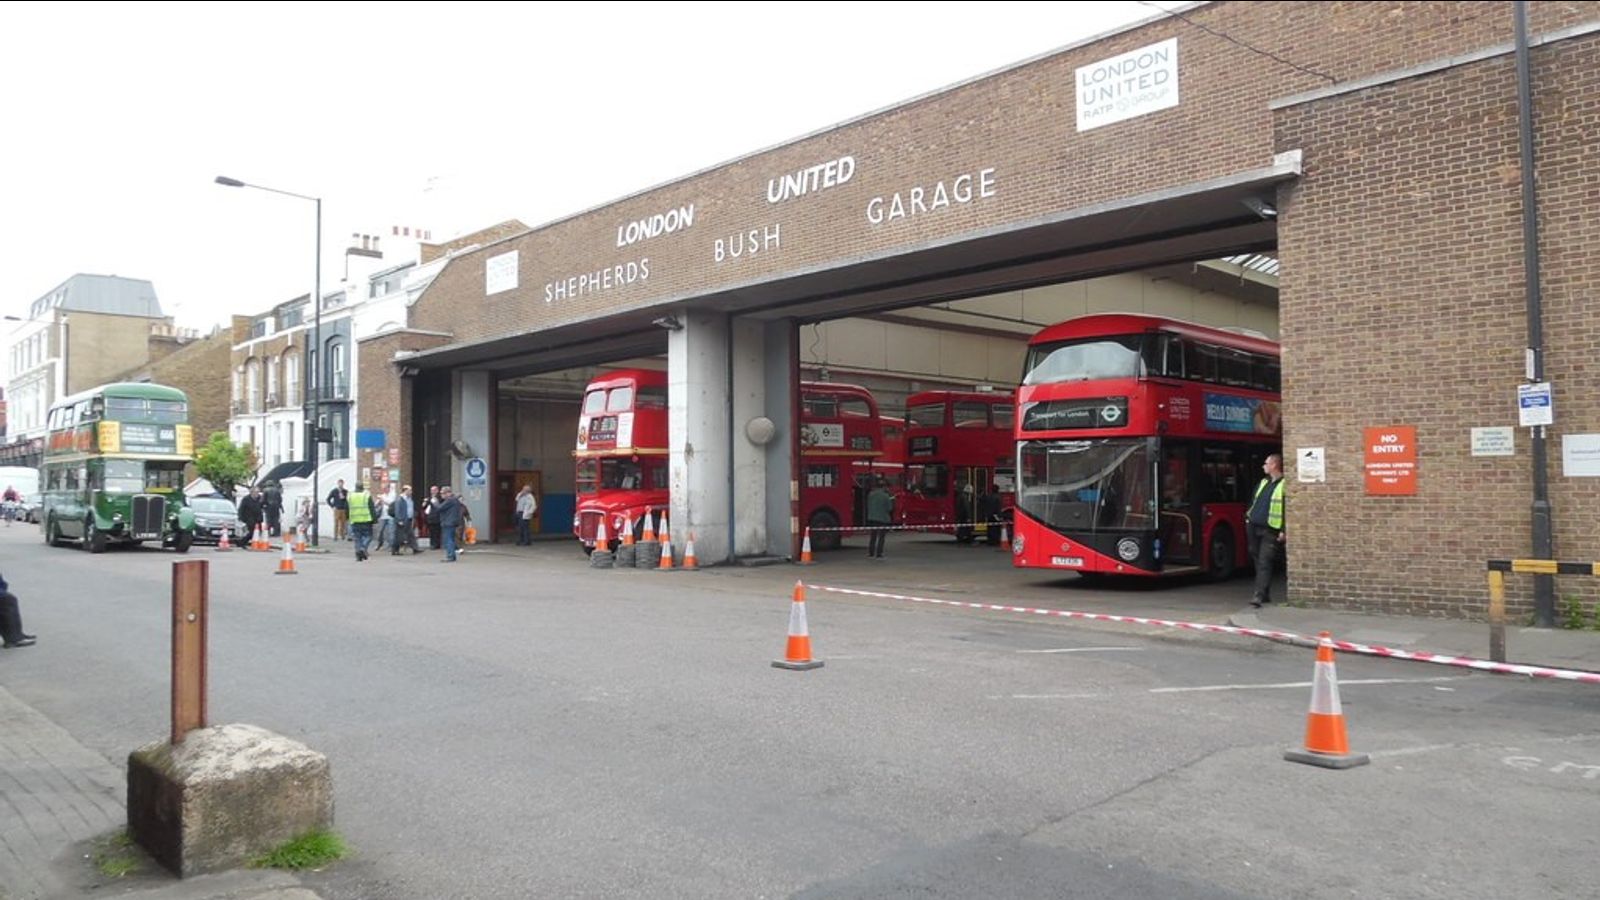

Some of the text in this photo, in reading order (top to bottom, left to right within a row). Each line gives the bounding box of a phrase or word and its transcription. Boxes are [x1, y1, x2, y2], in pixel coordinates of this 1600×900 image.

[1082, 47, 1168, 87] LONDON
[1083, 69, 1169, 105] UNITED
[1083, 104, 1114, 119] RATP
[617, 155, 855, 247] LONDON UNITED
[545, 168, 997, 303] SHEPHERDS BUSH GARAGE
[1372, 445, 1405, 454] ENTRY
[1381, 434, 1397, 443] NO
